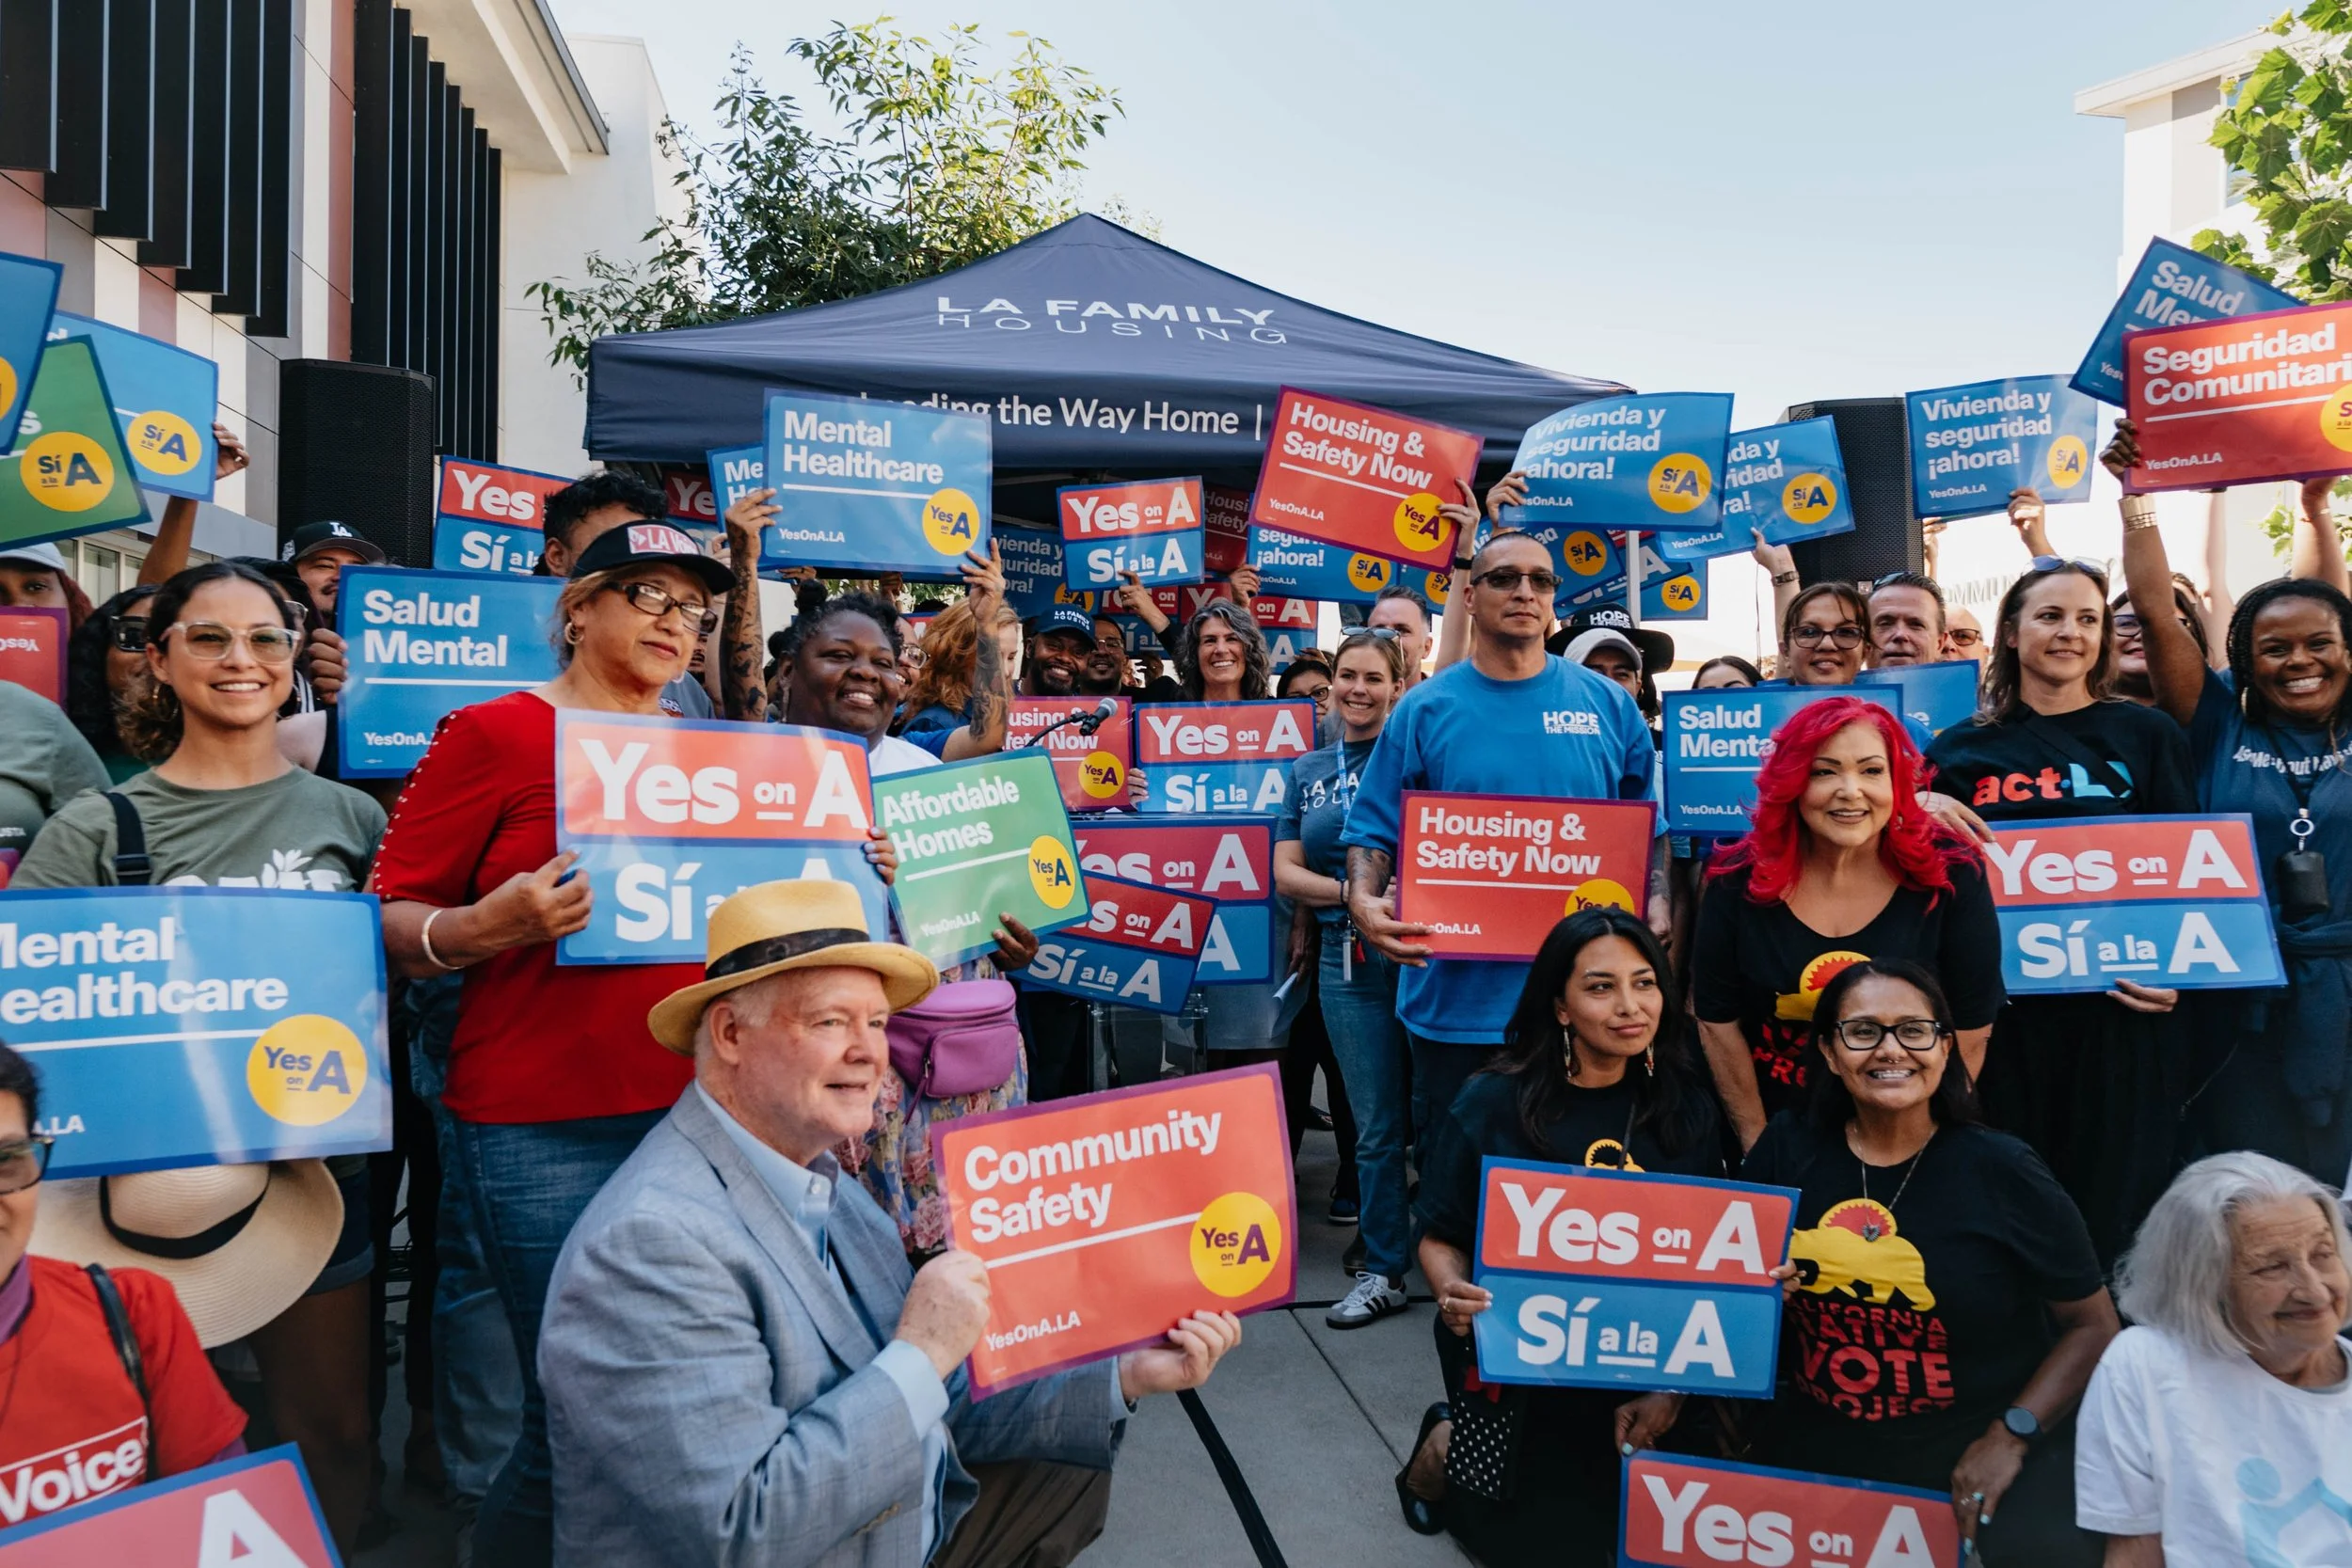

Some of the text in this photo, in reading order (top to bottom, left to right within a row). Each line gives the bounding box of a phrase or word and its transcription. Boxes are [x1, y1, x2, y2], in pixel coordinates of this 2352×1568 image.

[2152, 261, 2245, 315] Salud
[938, 297, 1275, 325] LA FAMILY
[938, 313, 1287, 344] HOUSING
[2144, 323, 2335, 375] Seguridad
[2144, 354, 2352, 405] Comunitari
[997, 395, 1239, 435] the Way Home
[1535, 405, 1667, 440] Vivienda y
[1922, 389, 2051, 421] Vivienda y
[144, 424, 187, 462] Sí A
[785, 410, 891, 449] Mental
[1291, 402, 1425, 458] Housing &
[1525, 430, 1661, 459] seguridad
[1926, 414, 2052, 449] seguridad
[784, 444, 944, 484] Healthcare
[1283, 431, 1433, 490] Safety Now
[1764, 439, 1779, 459] y
[1929, 443, 2021, 480] ¡ahora!
[2065, 451, 2079, 473] A
[2146, 452, 2223, 470] YesOnA.LA
[38, 452, 102, 486] Sí A
[1661, 468, 1699, 497] Sí A
[1725, 458, 1784, 489] ridad
[453, 469, 535, 520] Yes
[672, 477, 716, 515] Ye
[1205, 492, 1249, 513] Housi
[1269, 498, 1325, 521] YesOnA.LA
[1792, 486, 1828, 508] Sí A
[1929, 483, 1987, 499] YesOnA.LA
[930, 505, 953, 523] Yes
[950, 512, 971, 541] A
[1067, 487, 1196, 533] Yes on A
[1205, 509, 1248, 532] afety
[1404, 504, 1425, 522] Yes
[1418, 515, 1440, 541] A
[329, 522, 353, 537] LA
[646, 529, 671, 550] LA
[779, 528, 845, 544] YesOnA.LA
[1671, 531, 1724, 549] YesOnA.LA
[461, 531, 522, 571] Sí a
[1087, 538, 1188, 582] Sí a la A
[1257, 547, 1325, 567] ¡ahora!
[1570, 541, 1601, 562] Sí A
[1639, 546, 1672, 583] A
[1357, 560, 1383, 580] Sí A
[363, 590, 480, 627] Salud
[1159, 591, 1175, 601] on
[1257, 598, 1311, 623] on A
[1678, 586, 1693, 601] A
[1590, 610, 1629, 625] HOPE
[365, 629, 507, 667] Mental
[1270, 634, 1297, 667] A
[1146, 709, 1308, 756] Yes on A
[1543, 711, 1598, 728] HOPE
[1564, 725, 1600, 735] MISSION
[1678, 704, 1761, 730] Salud
[1049, 732, 1099, 750] Now
[1679, 734, 1776, 757] Menta
[579, 739, 869, 830] Yes on A
[1085, 765, 1119, 785] Yes A
[1165, 772, 1212, 813] Sí
[1213, 789, 1225, 802] a
[1229, 784, 1248, 801] la
[1253, 768, 1287, 812] A
[882, 776, 1020, 828] Affordable
[1680, 805, 1742, 816] YesOnA.LA
[890, 821, 993, 863] Homes
[1420, 807, 1586, 846] Housing &
[1033, 858, 1072, 887] Yes A
[1163, 833, 1260, 893] on A
[1416, 841, 1600, 877] Safety Now
[1982, 830, 2248, 896] Yes on A
[615, 863, 702, 942] Sí
[920, 911, 980, 937] YesOnA.LA
[1125, 912, 1151, 931] on
[1150, 902, 1194, 950] A
[1197, 913, 1241, 972] A
[2017, 912, 2241, 979] Sí a la A
[1026, 943, 1162, 1004] Sí a la A
[0, 971, 289, 1024] ealthcare
[264, 1045, 352, 1095] Yes on A
[964, 1109, 1222, 1192] Community
[969, 1181, 1113, 1243] Safety
[1500, 1182, 1766, 1275] Yes on A
[1200, 1224, 1270, 1265] Yes on A
[985, 1310, 1081, 1352] YesOnA.LA
[1517, 1294, 1736, 1378] Sí a la A
[1797, 1331, 1955, 1399] VOTE
[0, 1436, 143, 1524] Voice
[197, 1488, 311, 1568] A
[1642, 1474, 1936, 1568] Yes on A
